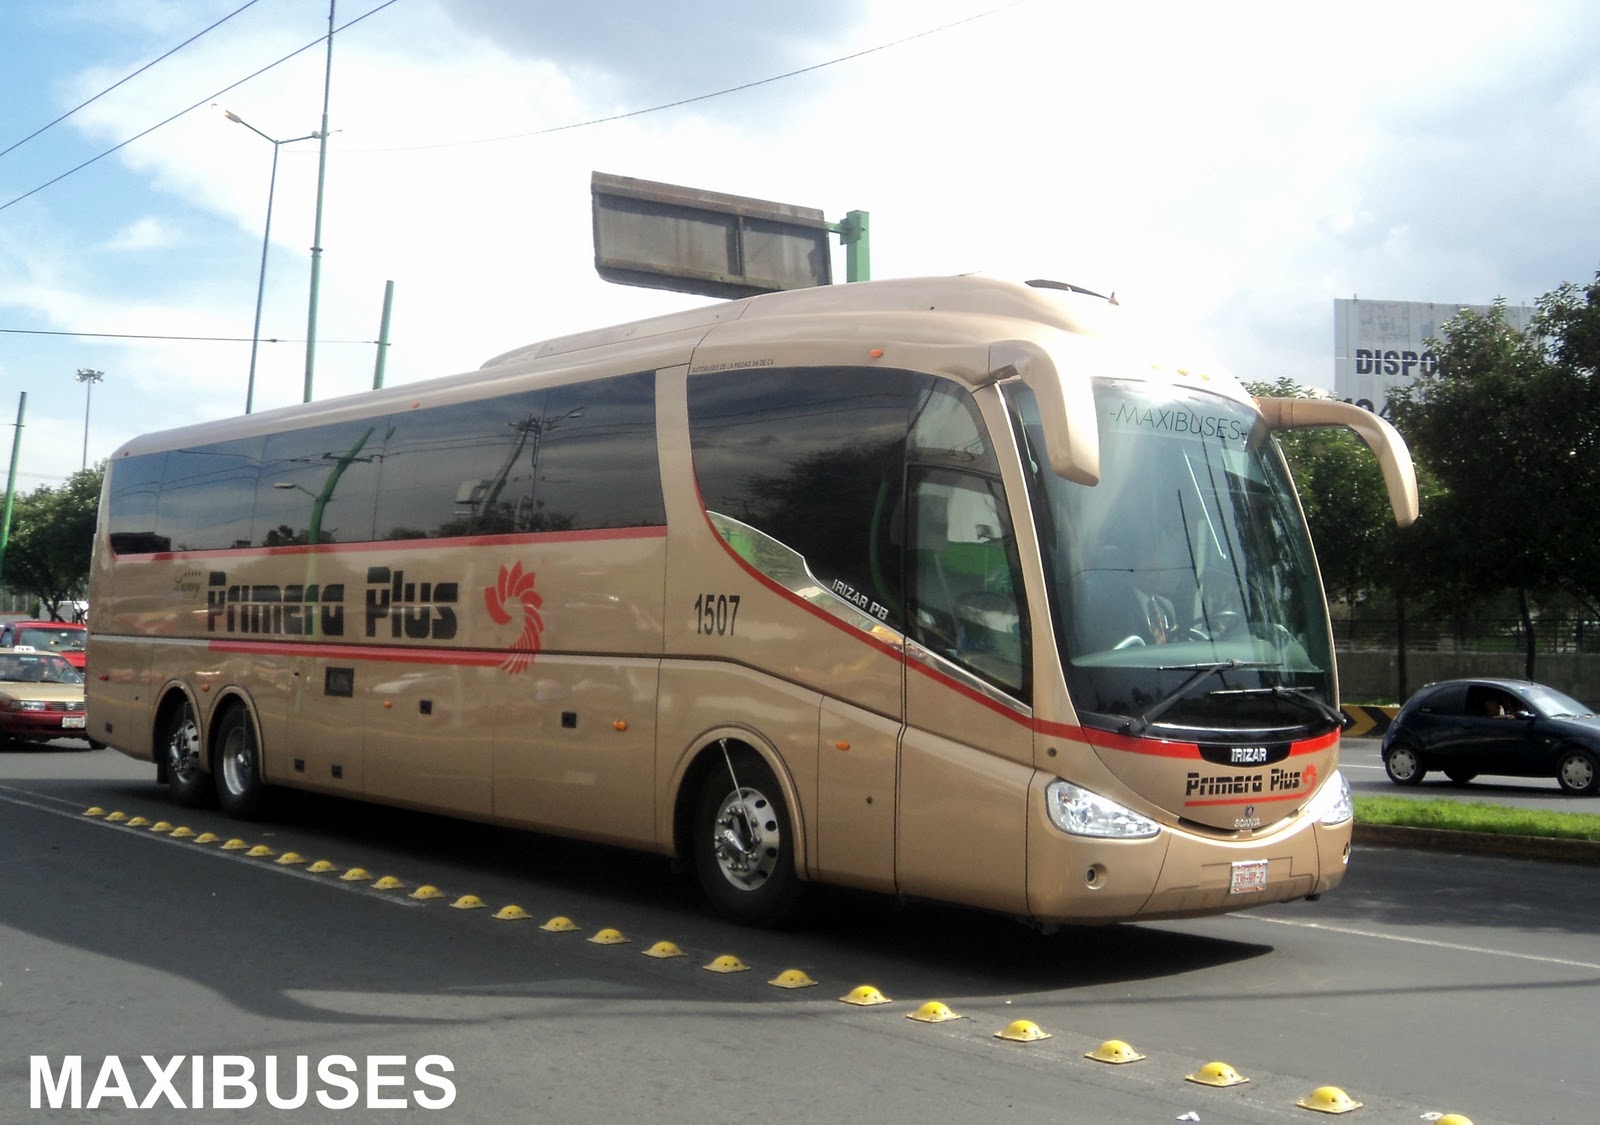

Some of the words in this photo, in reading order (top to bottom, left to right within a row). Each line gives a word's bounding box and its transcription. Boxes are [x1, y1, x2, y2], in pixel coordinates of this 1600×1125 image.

[207, 571, 345, 636] Primera
[366, 566, 458, 640] Plus
[694, 593, 740, 636] 1507
[831, 578, 869, 609] IRIZAR
[869, 601, 889, 620] PB
[1231, 747, 1267, 762] IRIZAR
[1186, 772, 1263, 796] Primera
[1270, 768, 1301, 791] Plus
